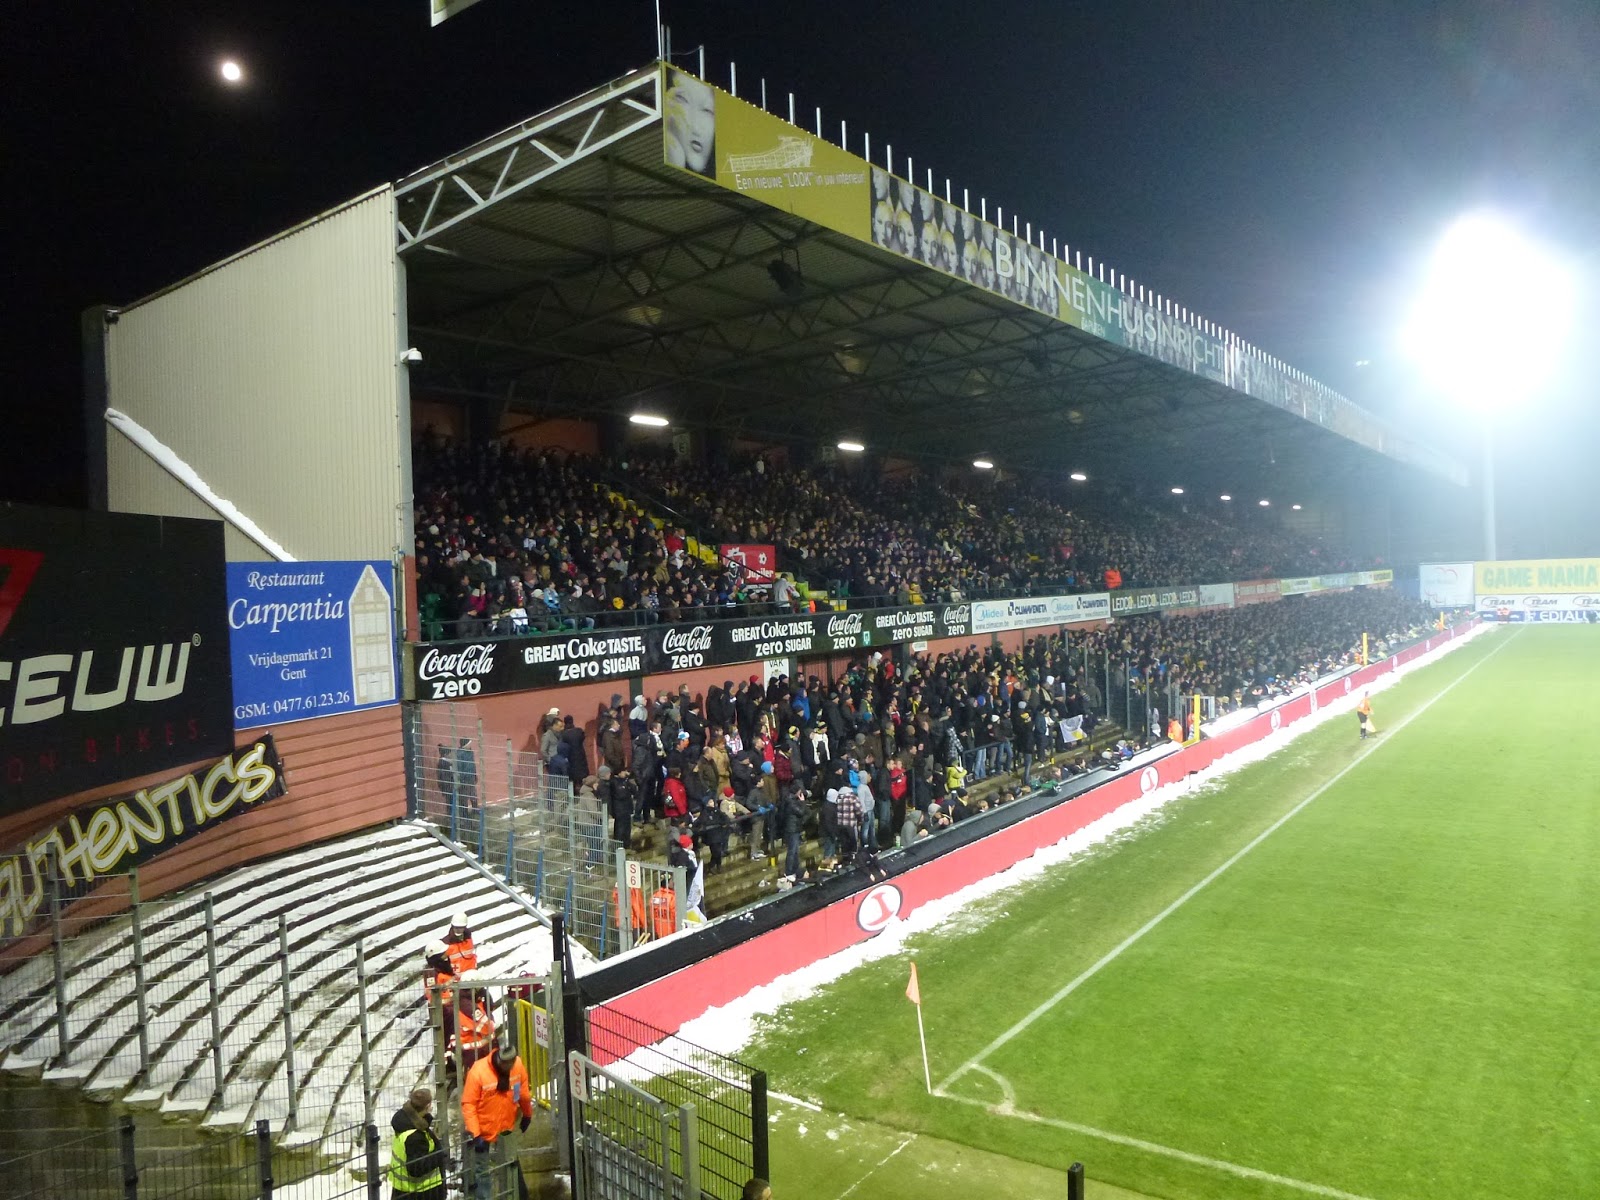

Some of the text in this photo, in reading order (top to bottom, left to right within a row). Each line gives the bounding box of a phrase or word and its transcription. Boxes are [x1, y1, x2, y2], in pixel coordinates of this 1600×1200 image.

[735, 174, 752, 190] Een
[247, 571, 325, 590] Restaurant
[1483, 564, 1598, 589] GAME MANIA
[1489, 598, 1515, 607] TEAM
[1531, 597, 1558, 606] TEAM
[228, 593, 345, 633] Carpentia
[876, 615, 896, 628] GREAT
[896, 611, 916, 626] Coke
[943, 604, 970, 626] Coca-Cola
[731, 620, 816, 643] GREAT Coke TASTE,
[827, 613, 864, 638] Coca-Cola
[892, 624, 933, 640] zero SUGAR
[947, 624, 965, 636] zero
[524, 636, 646, 664] GREAT Coke TASTE,
[662, 625, 712, 656] Coca-Cola
[755, 636, 812, 657] zero SUGAR
[833, 636, 856, 650] zero
[249, 647, 332, 669] Vrijdagmarkt 21
[419, 643, 497, 681] Coca-Cola
[671, 650, 704, 670] zero
[768, 659, 784, 668] VAK
[280, 668, 307, 681] Gent
[558, 656, 640, 682] zero SUGAR
[432, 677, 481, 699] zero
[234, 691, 350, 720] GSM: 0477.61.23.26
[85, 719, 199, 763] BIKES
[629, 863, 637, 874] S
[630, 876, 637, 886] 6
[535, 1015, 548, 1029] S 5
[573, 1059, 581, 1077] S
[575, 1080, 582, 1096] 5
